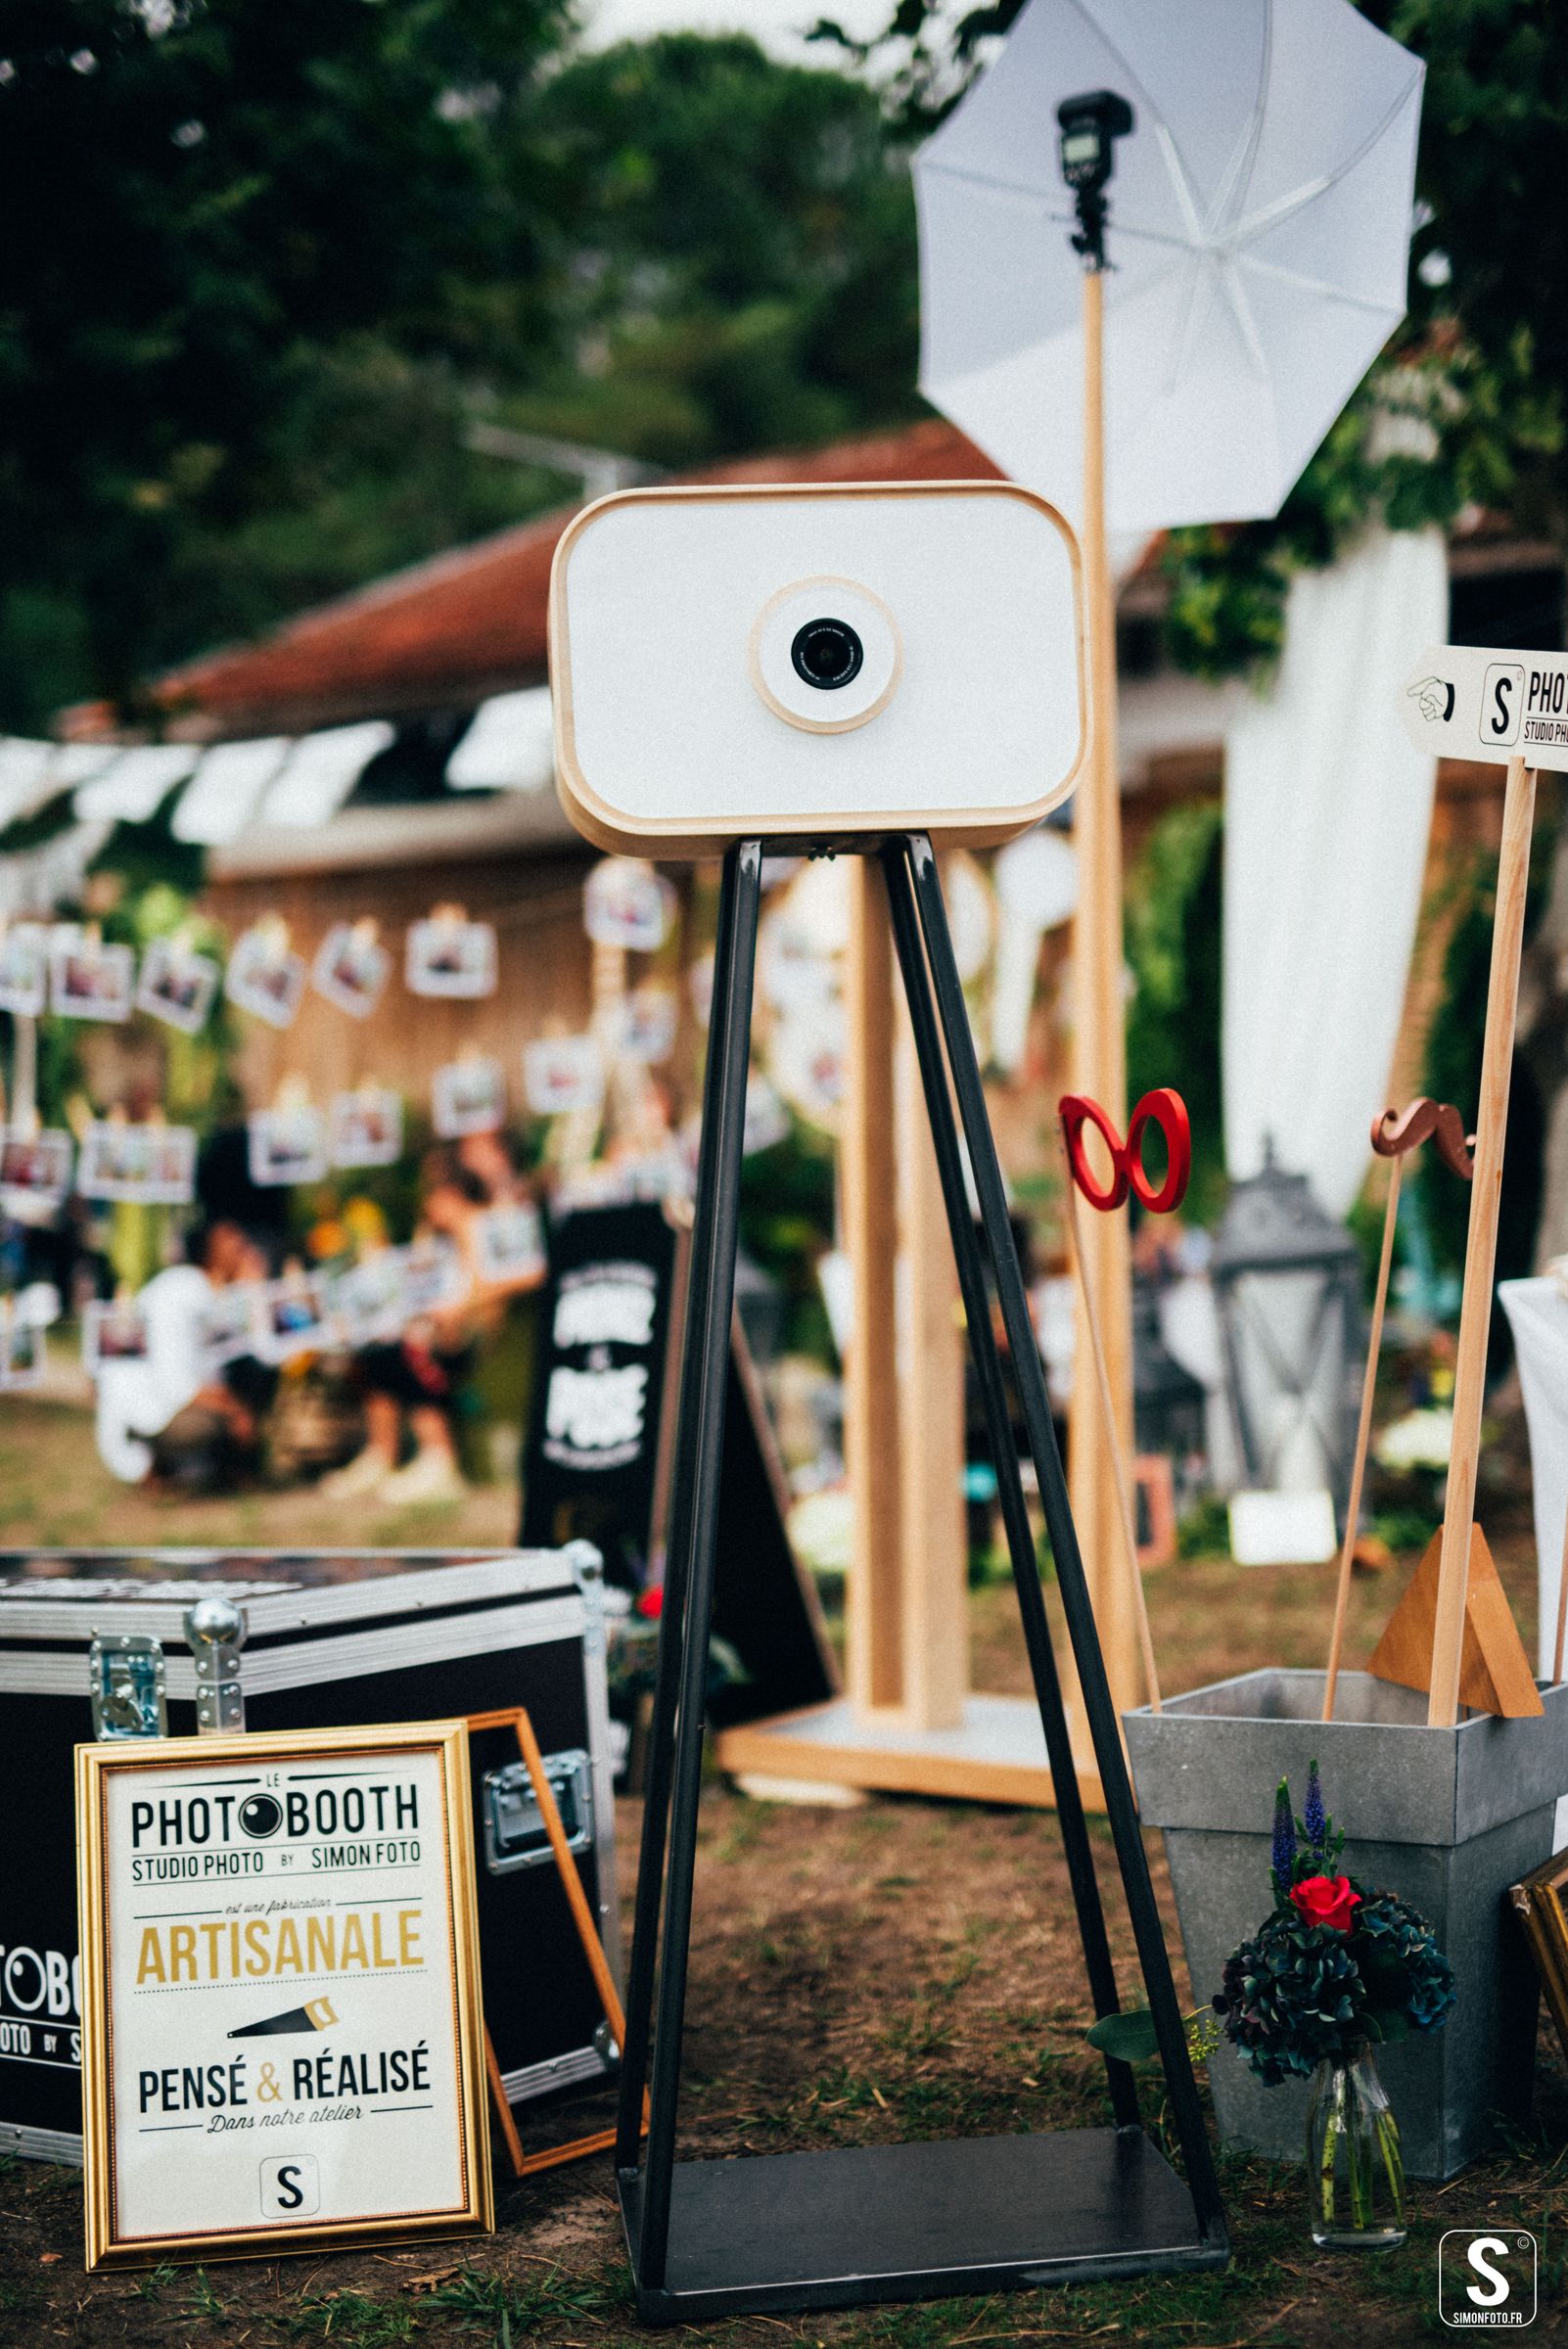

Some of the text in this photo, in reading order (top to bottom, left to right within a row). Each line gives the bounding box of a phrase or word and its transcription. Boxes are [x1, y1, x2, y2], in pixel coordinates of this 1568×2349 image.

[1491, 677, 1512, 735] S
[1528, 671, 1568, 714] PHO
[1524, 720, 1554, 741] STUDIO
[266, 1773, 279, 1787] LE
[132, 1840, 421, 1881] STUDIO PHOTO BY SIMON FOTO
[225, 1903, 242, 1915] est
[244, 1904, 264, 1914] une
[136, 1910, 425, 1985] ARTISANALE
[43, 2034, 58, 2053] BY
[139, 2040, 431, 2114] PENSÉ & RÉALISÉ
[207, 2103, 365, 2135] Dans notre atelier
[277, 2164, 303, 2209] S
